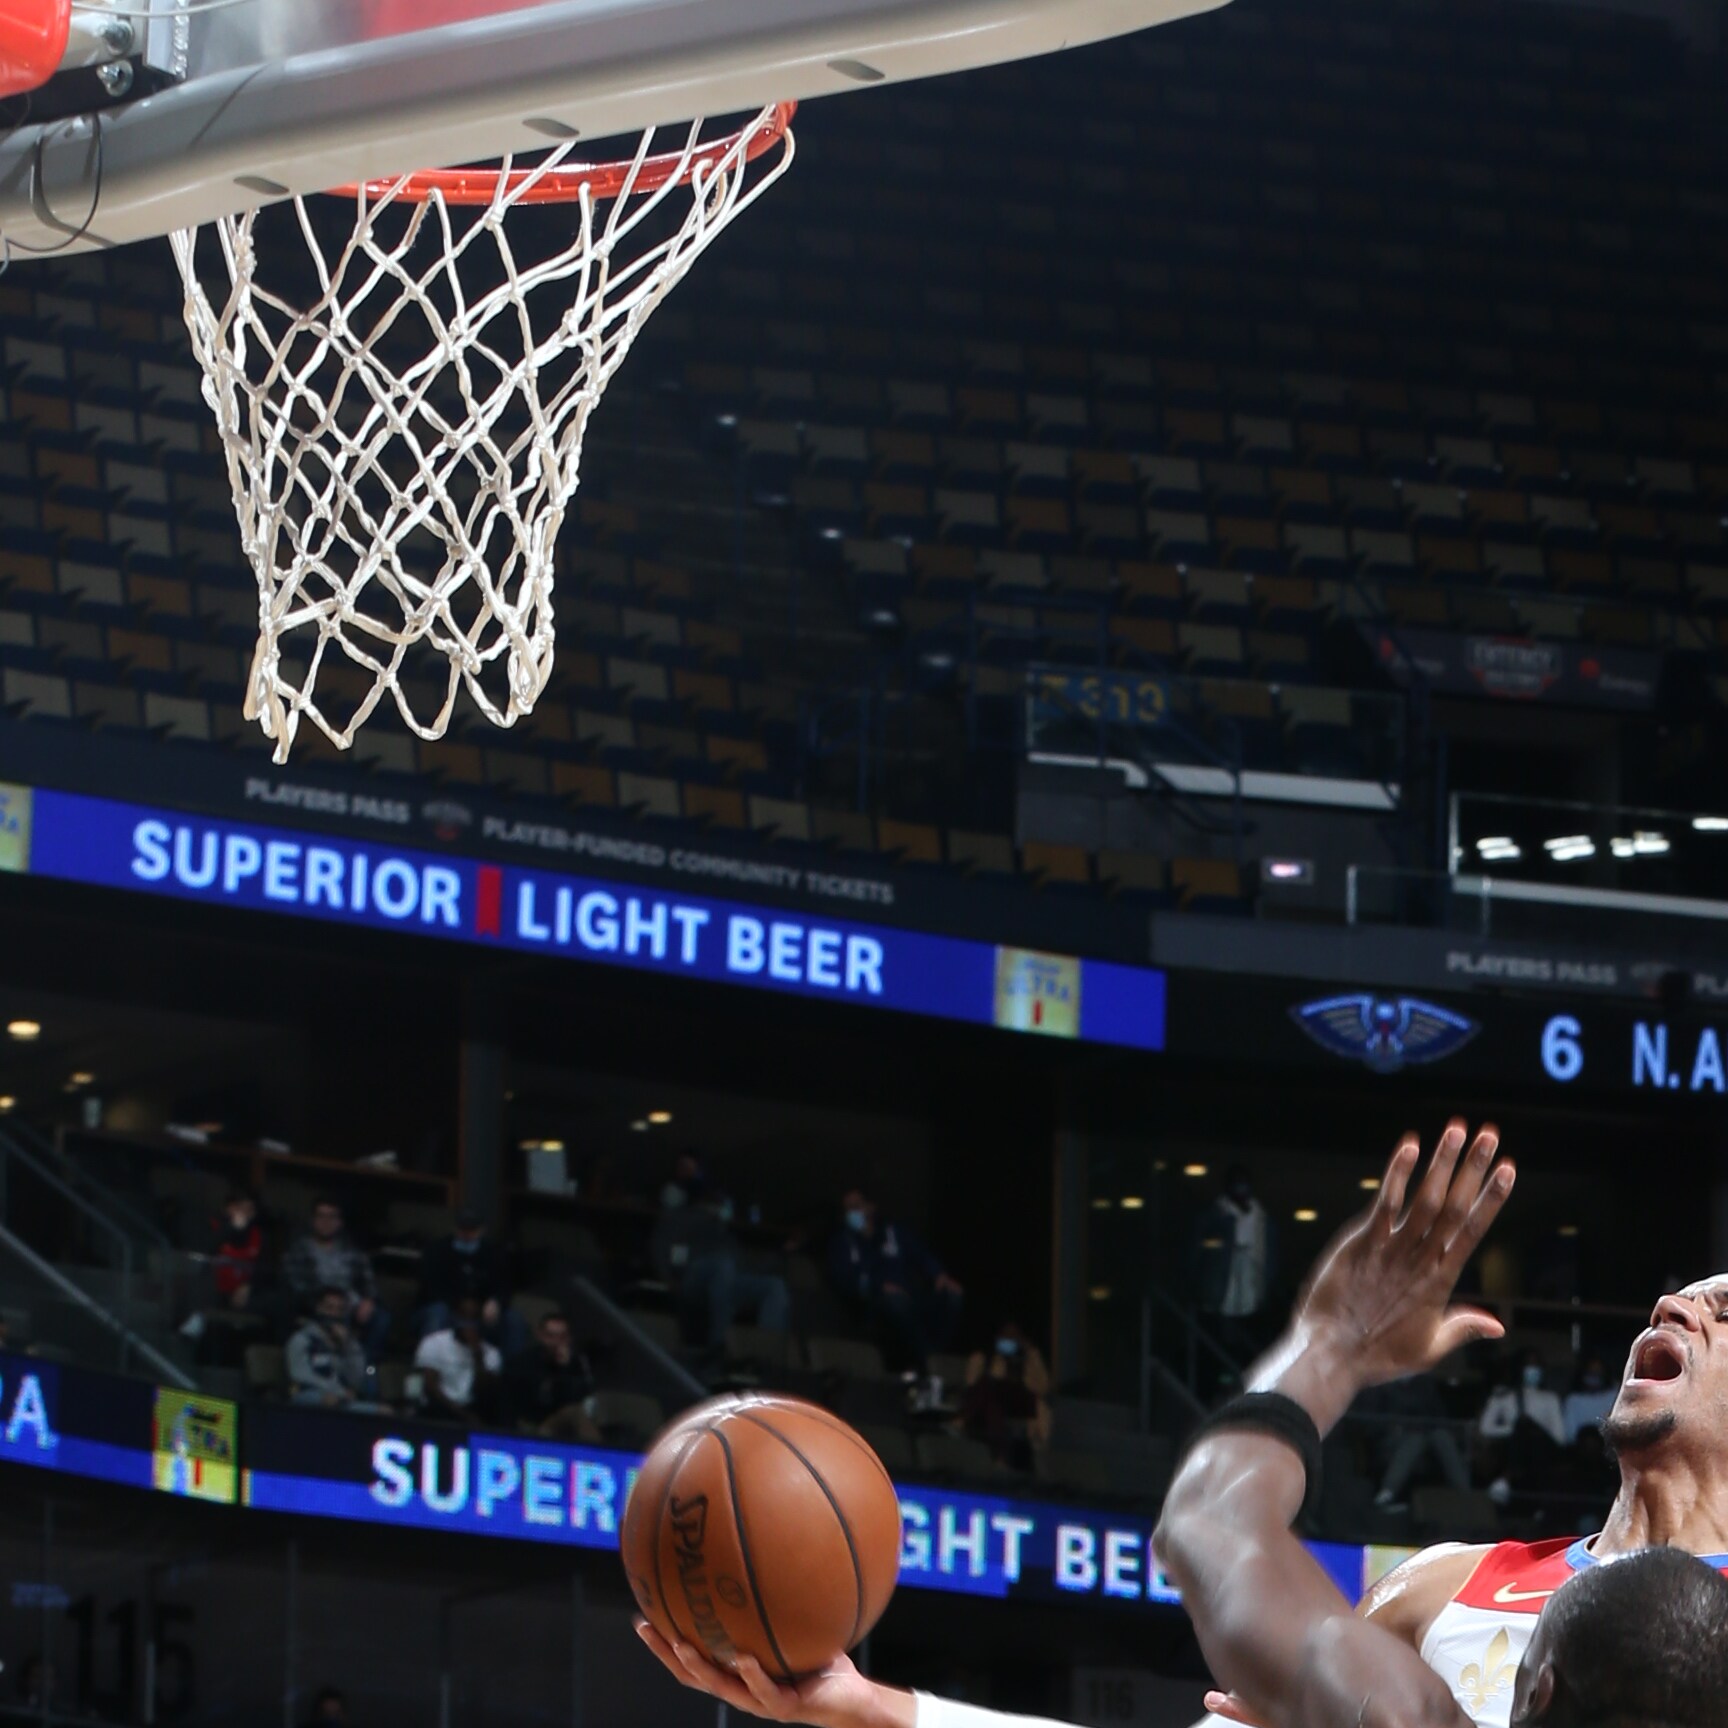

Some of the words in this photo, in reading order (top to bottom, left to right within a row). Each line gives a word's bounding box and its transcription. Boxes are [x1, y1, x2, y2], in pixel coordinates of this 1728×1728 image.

[246, 777, 348, 816] PLAYERS
[351, 792, 411, 824] PASS
[131, 820, 461, 927] SUPERIOR
[669, 848, 801, 890] COMMUNITY
[804, 870, 895, 905] TICKETS
[518, 881, 709, 964] LIGHT
[726, 914, 884, 993] BEER
[1446, 952, 1551, 983] PLAYERS
[1555, 961, 1618, 987] PASS
[1540, 1014, 1584, 1082] 6
[1632, 1022, 1680, 1089] N.
[370, 1436, 642, 1536] SUPER
[899, 1498, 1034, 1583] GHT
[1055, 1523, 1184, 1606] BEE
